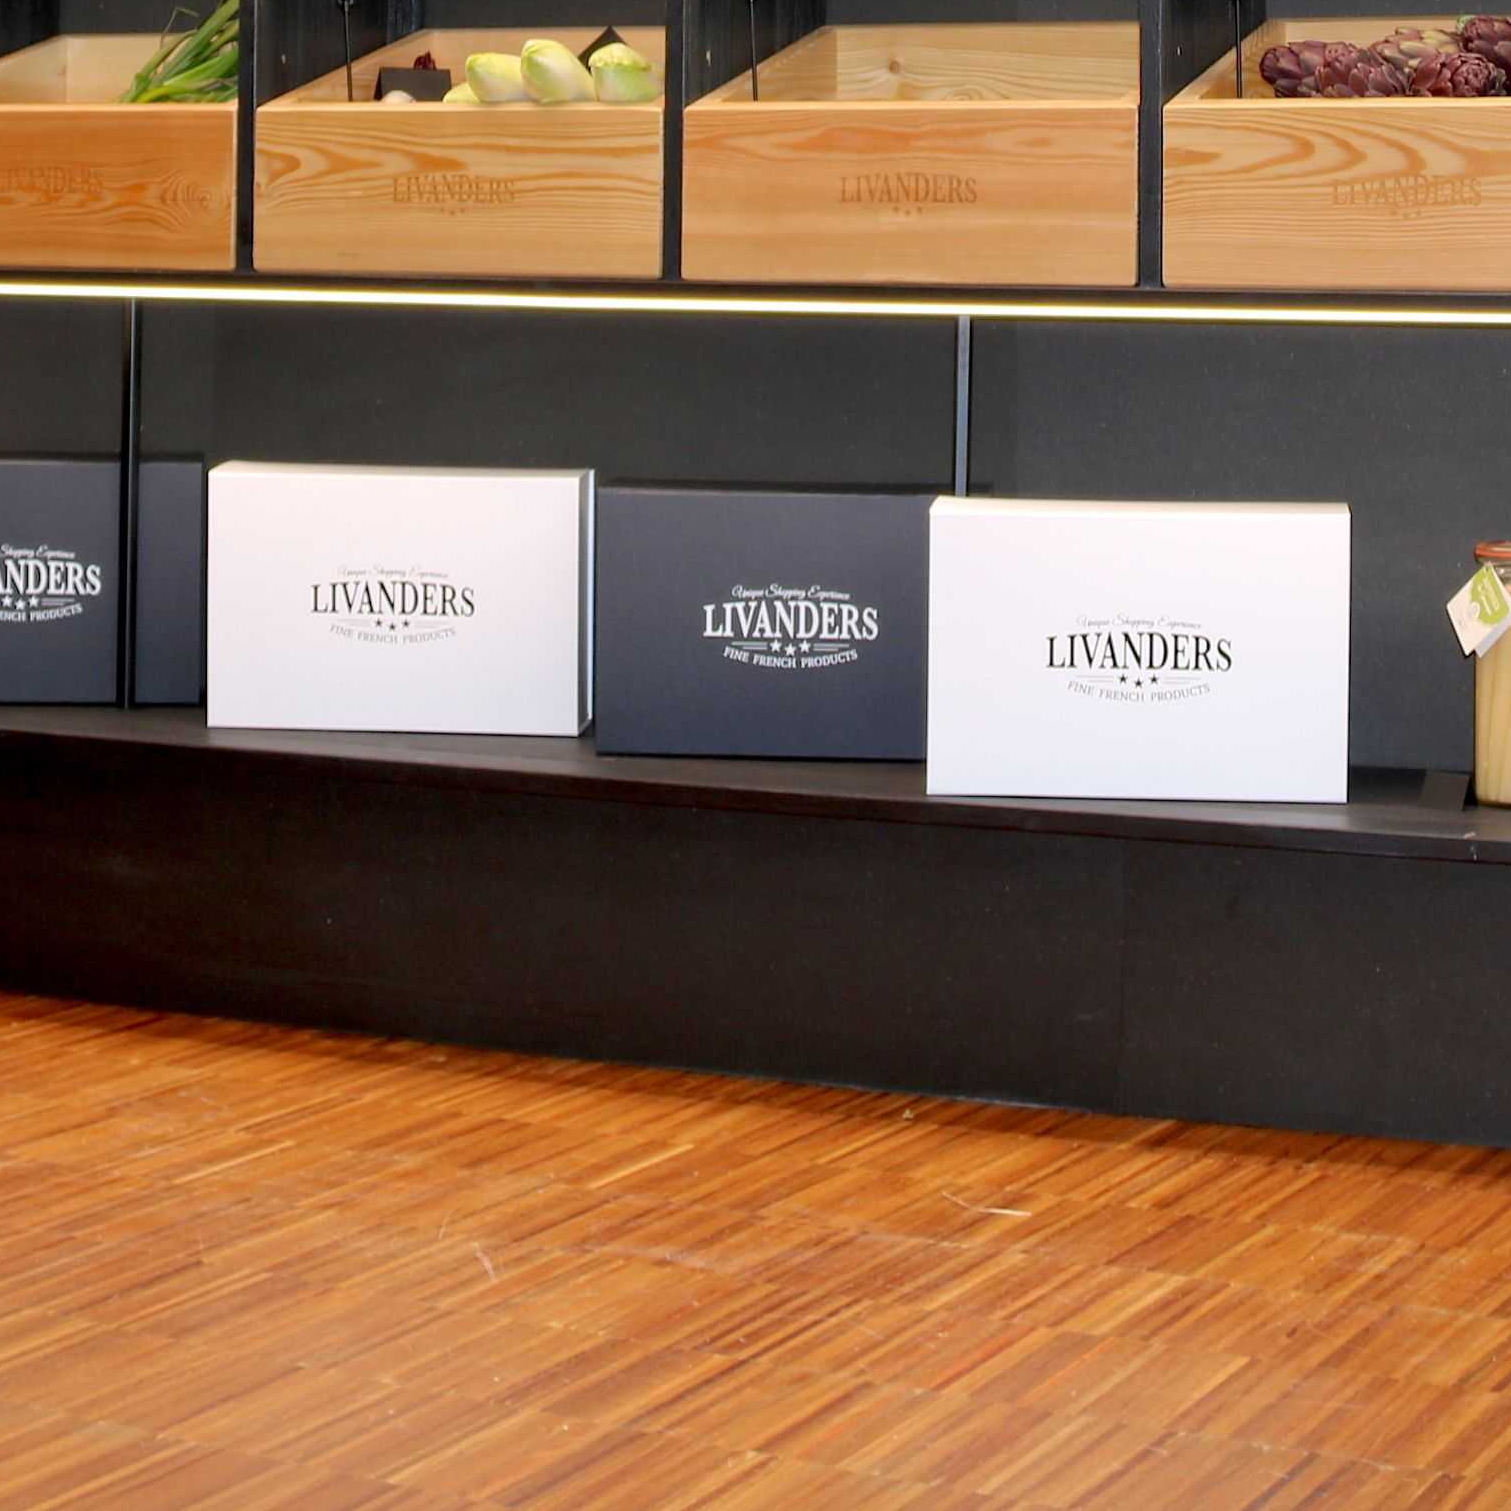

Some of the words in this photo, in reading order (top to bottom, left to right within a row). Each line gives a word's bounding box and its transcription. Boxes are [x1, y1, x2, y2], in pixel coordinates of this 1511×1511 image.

[392, 173, 516, 203] LIVANDERS
[839, 171, 978, 205] LIVANDERS
[1332, 173, 1482, 207] LIVANDERS
[311, 579, 476, 617] LIVANDERS
[764, 583, 807, 600] Shopping
[29, 603, 84, 622] PRODUCTS
[702, 600, 879, 641] LIVANDERS
[1112, 612, 1154, 628] Shopping
[329, 624, 354, 638] FINE
[357, 631, 398, 644] FRENCH
[402, 626, 457, 645] PRODUCTS
[723, 645, 749, 663] FINE
[752, 654, 797, 669] FRENCH
[800, 648, 858, 669] PRODUCTS
[1046, 631, 1233, 673] LIVANDERS
[1067, 680, 1095, 696] FINE
[1098, 689, 1145, 703] FRENCH
[1150, 682, 1211, 702] PRODUCTS
